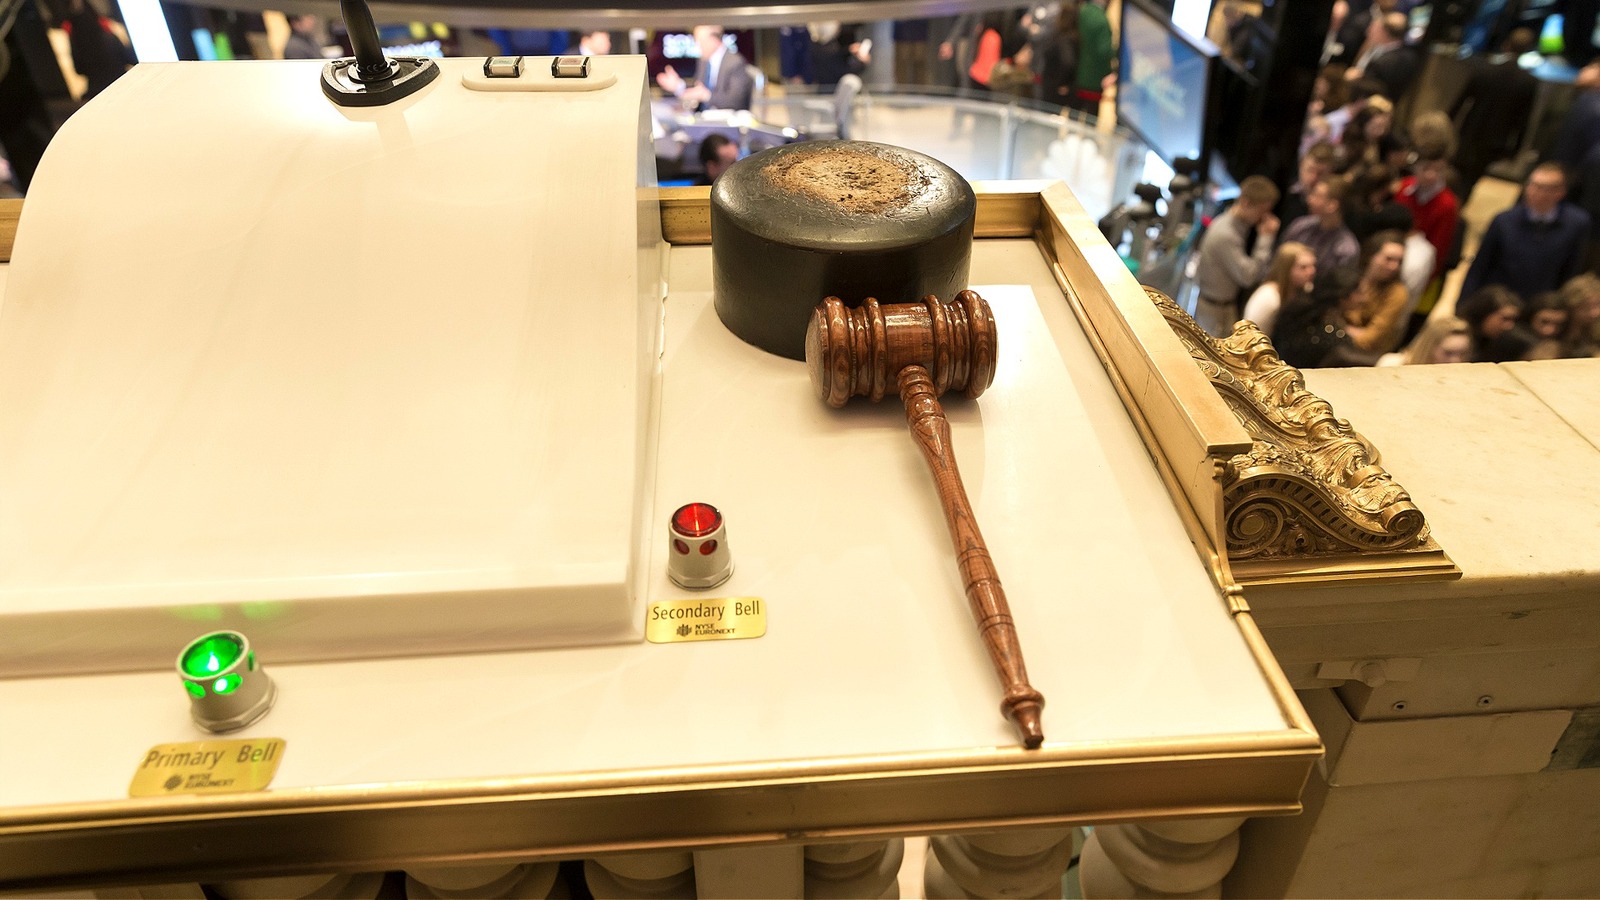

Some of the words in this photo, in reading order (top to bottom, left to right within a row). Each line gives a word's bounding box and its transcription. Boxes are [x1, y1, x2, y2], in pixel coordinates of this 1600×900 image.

[652, 603, 726, 621] Secondary
[735, 600, 760, 616] Bell
[695, 628, 736, 636] EURONEXT
[142, 748, 226, 770] Primary
[237, 742, 278, 764] Bell
